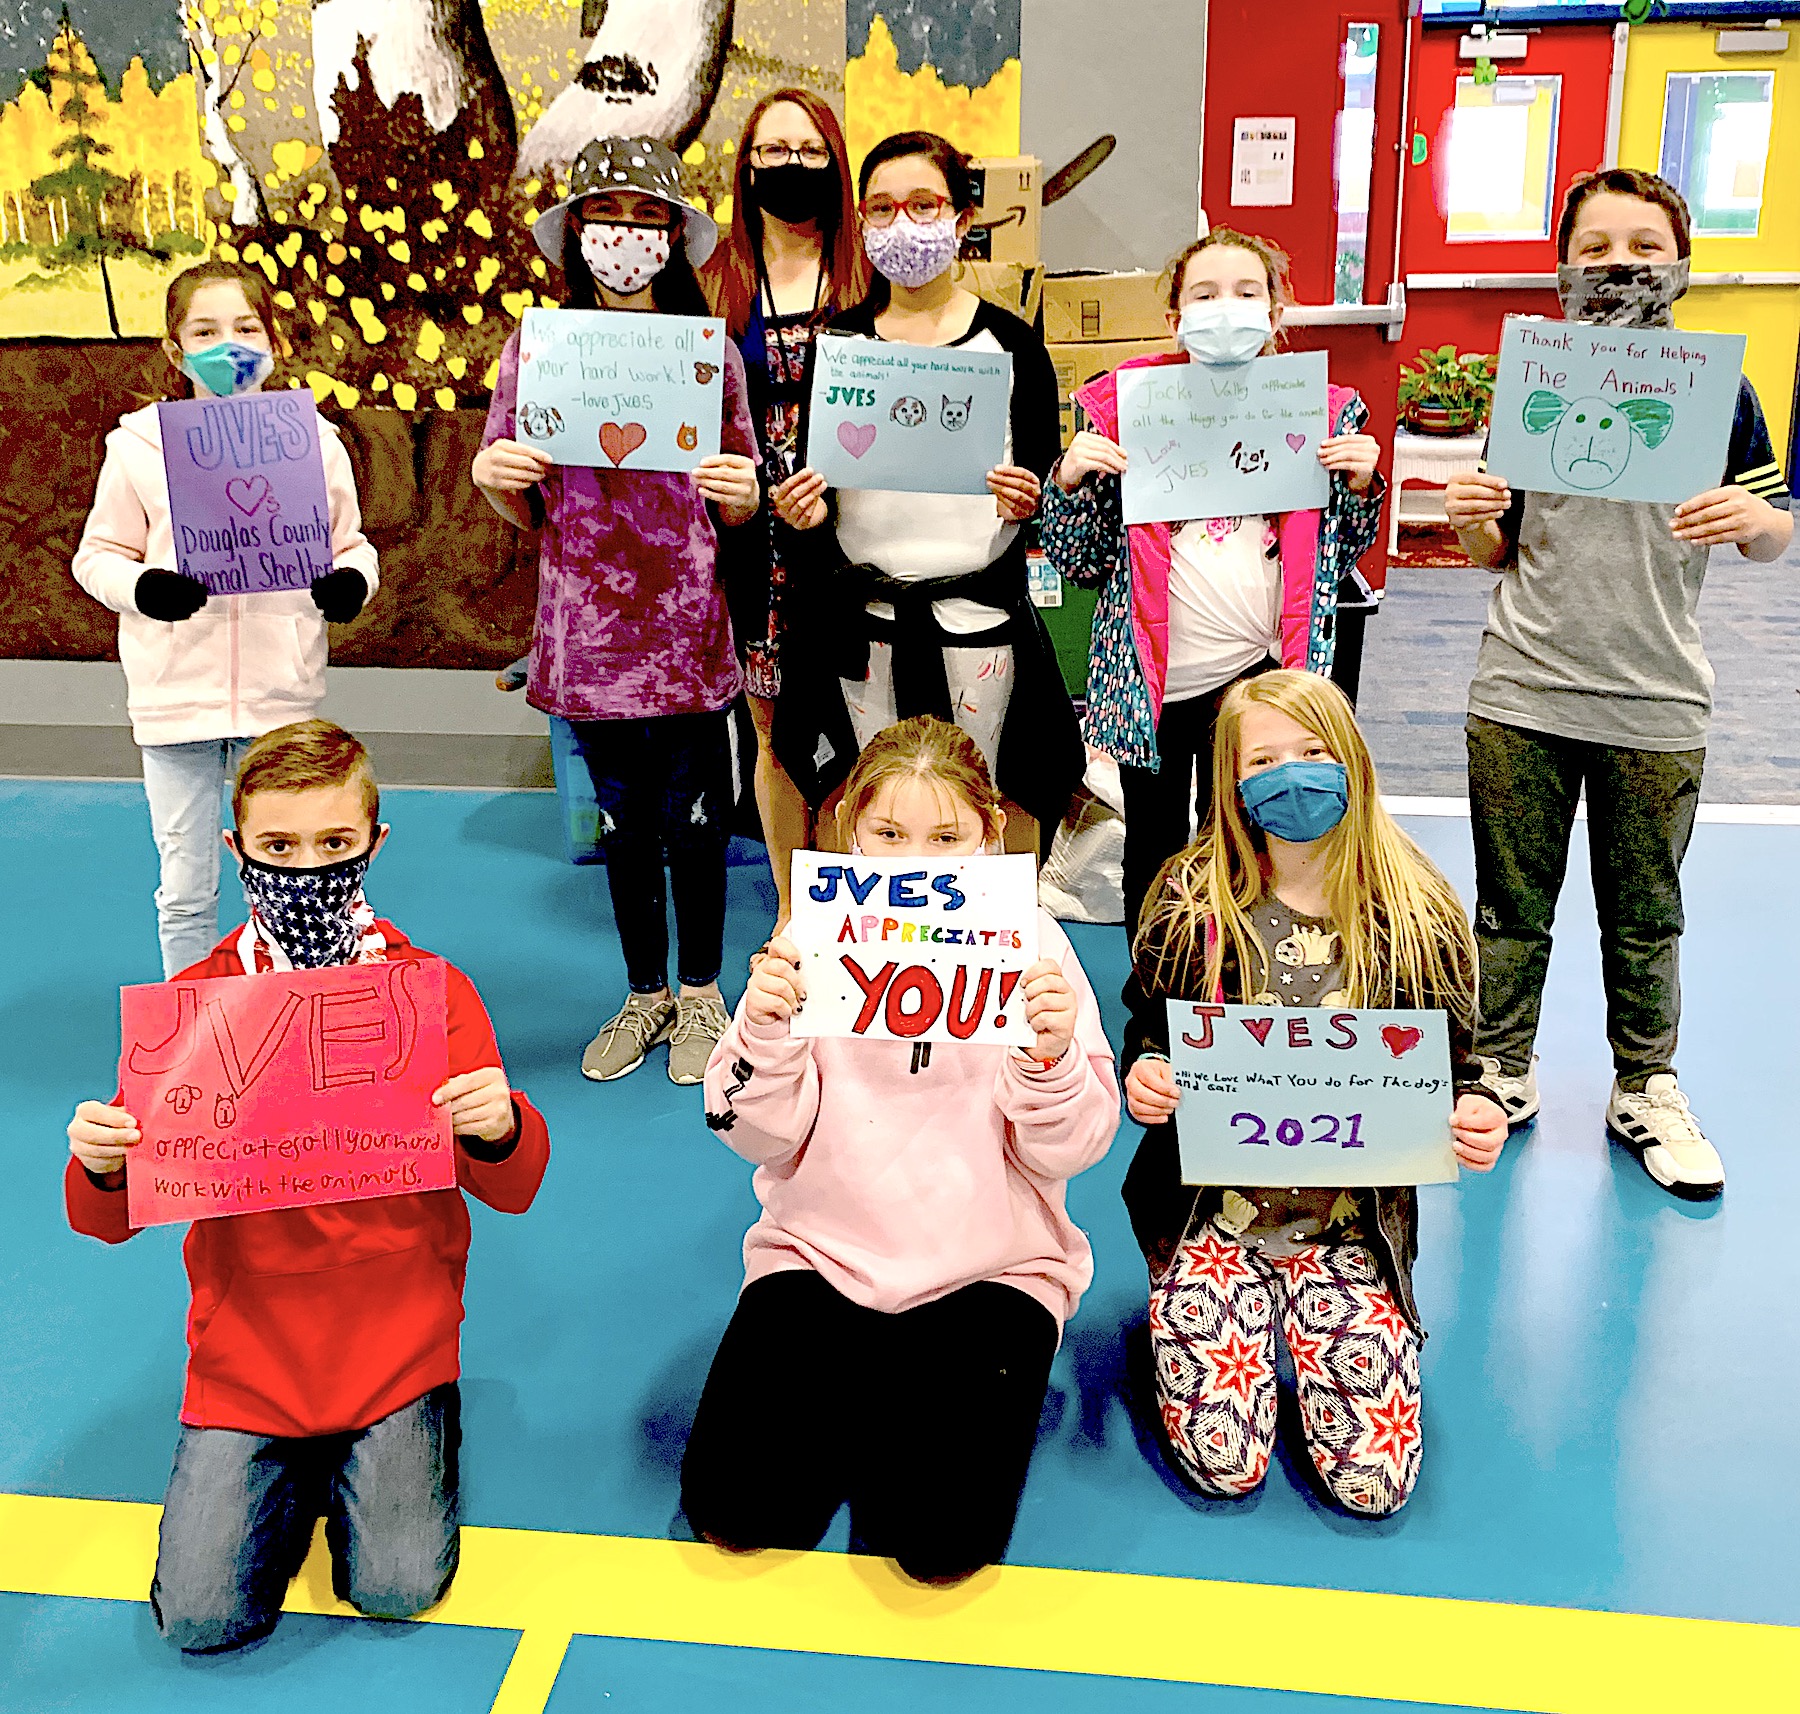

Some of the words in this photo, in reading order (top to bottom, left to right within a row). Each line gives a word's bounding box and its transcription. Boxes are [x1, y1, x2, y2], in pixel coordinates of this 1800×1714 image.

[567, 326, 665, 357] appreciate
[675, 329, 694, 352] all
[1520, 328, 1573, 351] Thank
[1591, 341, 1617, 356] you
[1627, 342, 1648, 358] for
[1661, 346, 1707, 366] Helping
[537, 359, 569, 382] your
[580, 361, 618, 380] hard
[821, 344, 847, 365] We
[897, 357, 909, 367] all
[912, 363, 928, 374] your
[930, 361, 949, 371] hard
[951, 365, 975, 373] work
[979, 366, 1000, 375] with
[1522, 360, 1567, 388] The
[1136, 380, 1192, 409] Jacks
[1133, 414, 1151, 427] all
[1160, 413, 1175, 426] the
[1245, 411, 1256, 420] do
[1280, 408, 1293, 418] the
[186, 398, 310, 471] JVES
[1155, 460, 1208, 493] JVES
[181, 516, 260, 562] Douglas
[269, 505, 329, 548] County
[809, 866, 966, 911] JVES
[837, 914, 1022, 949] APPRECIATES
[839, 954, 1023, 1040] YOU!
[128, 960, 421, 1098] JVES
[1214, 1073, 1239, 1083] Love
[1325, 1077, 1342, 1087] do
[1348, 1074, 1374, 1086] for
[1230, 1112, 1365, 1149] 2021
[155, 1177, 206, 1197] work
[211, 1177, 272, 1203] with
[278, 1174, 316, 1193] the
